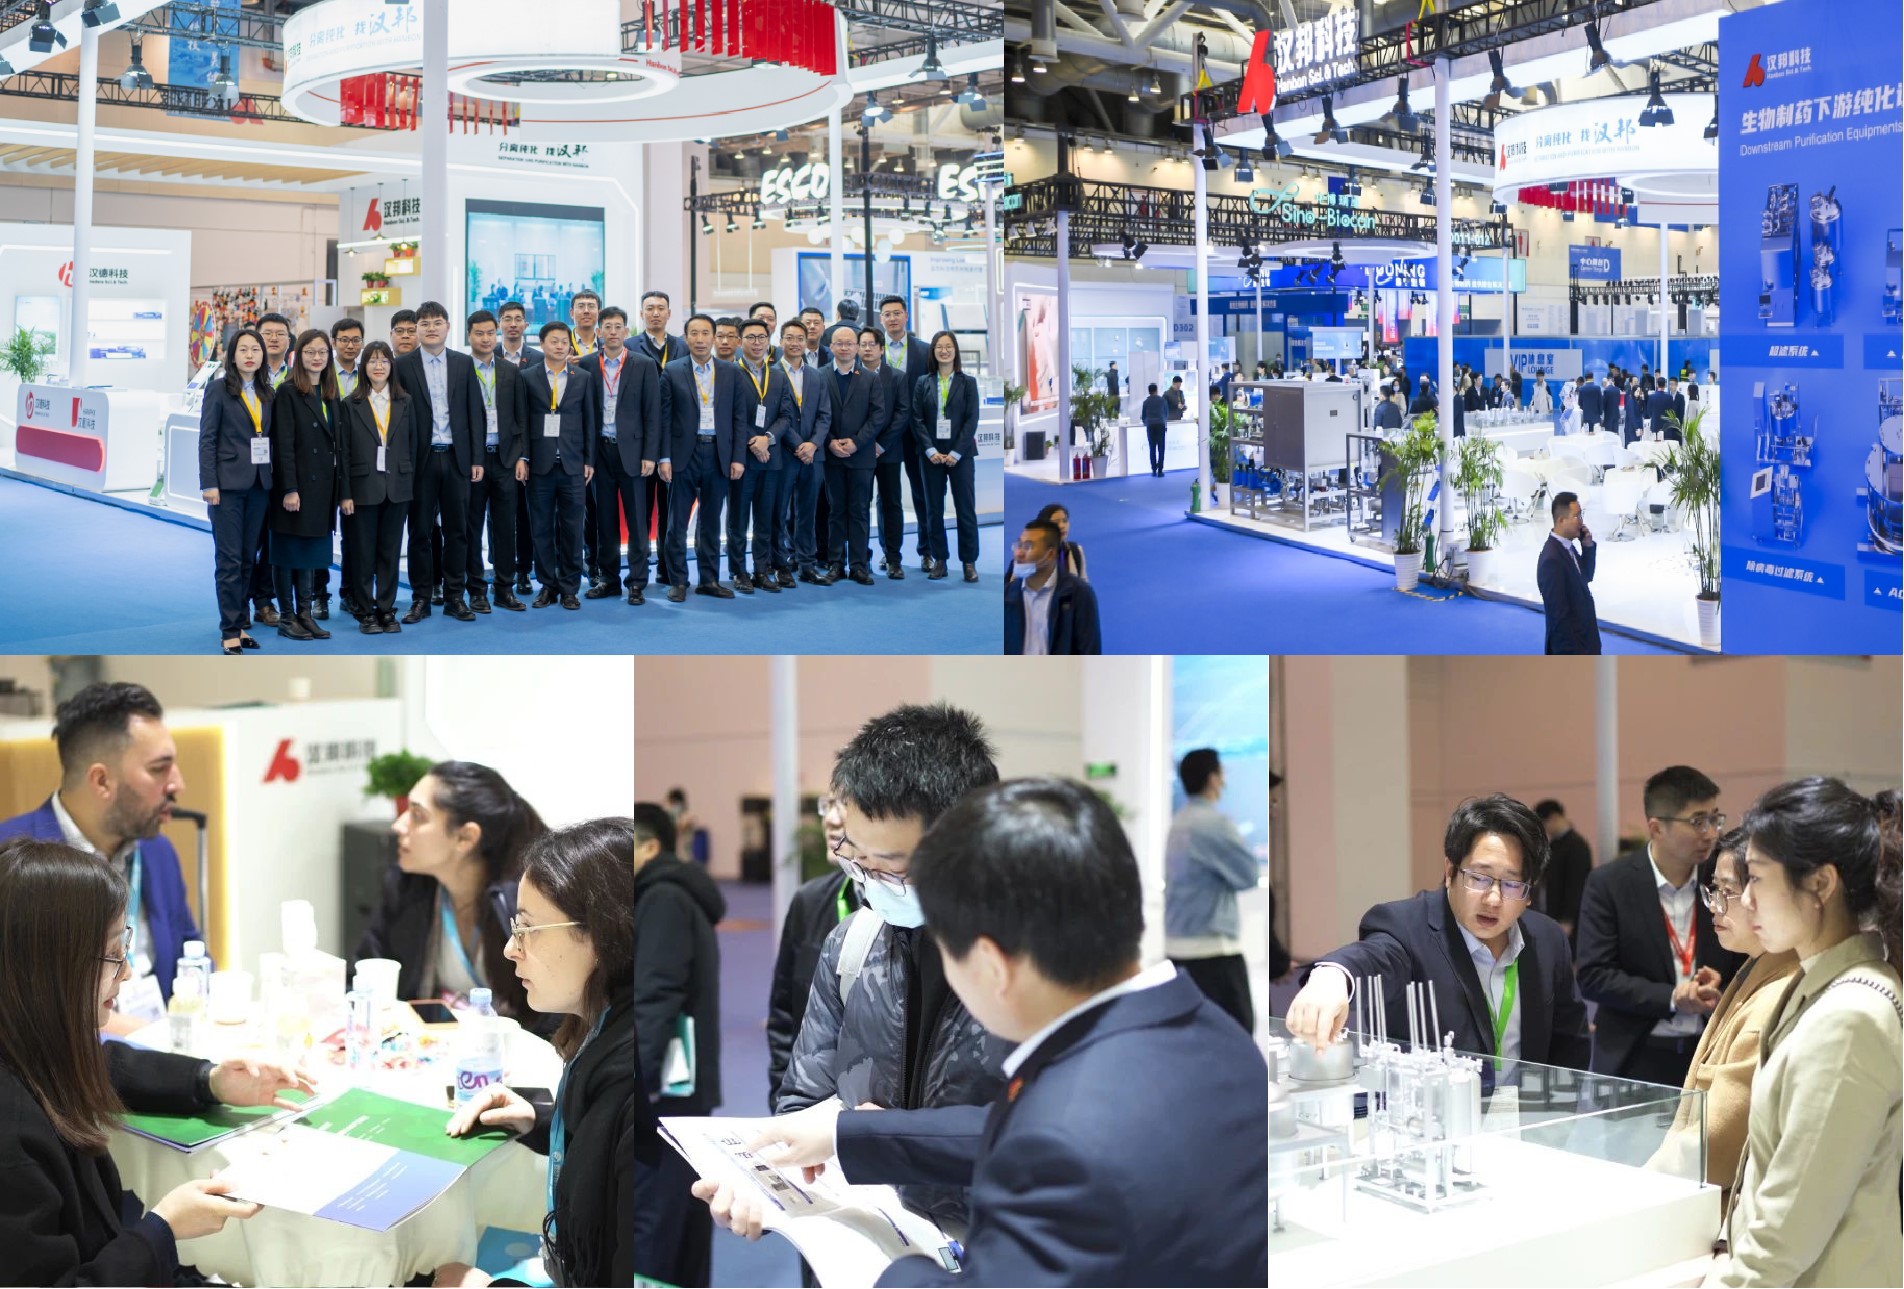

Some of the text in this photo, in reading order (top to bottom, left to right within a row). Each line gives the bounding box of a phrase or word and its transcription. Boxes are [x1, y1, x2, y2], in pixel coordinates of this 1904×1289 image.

[1275, 6, 1358, 74] 汉邦科技
[1766, 46, 1811, 71] 汉邦科技
[1276, 75, 1308, 94] Hanbon
[1740, 119, 1903, 157] Downstream Purification Equipments
[761, 163, 831, 205] ESCO
[383, 198, 420, 218] 汉邦科技
[1510, 353, 1528, 374] VIP
